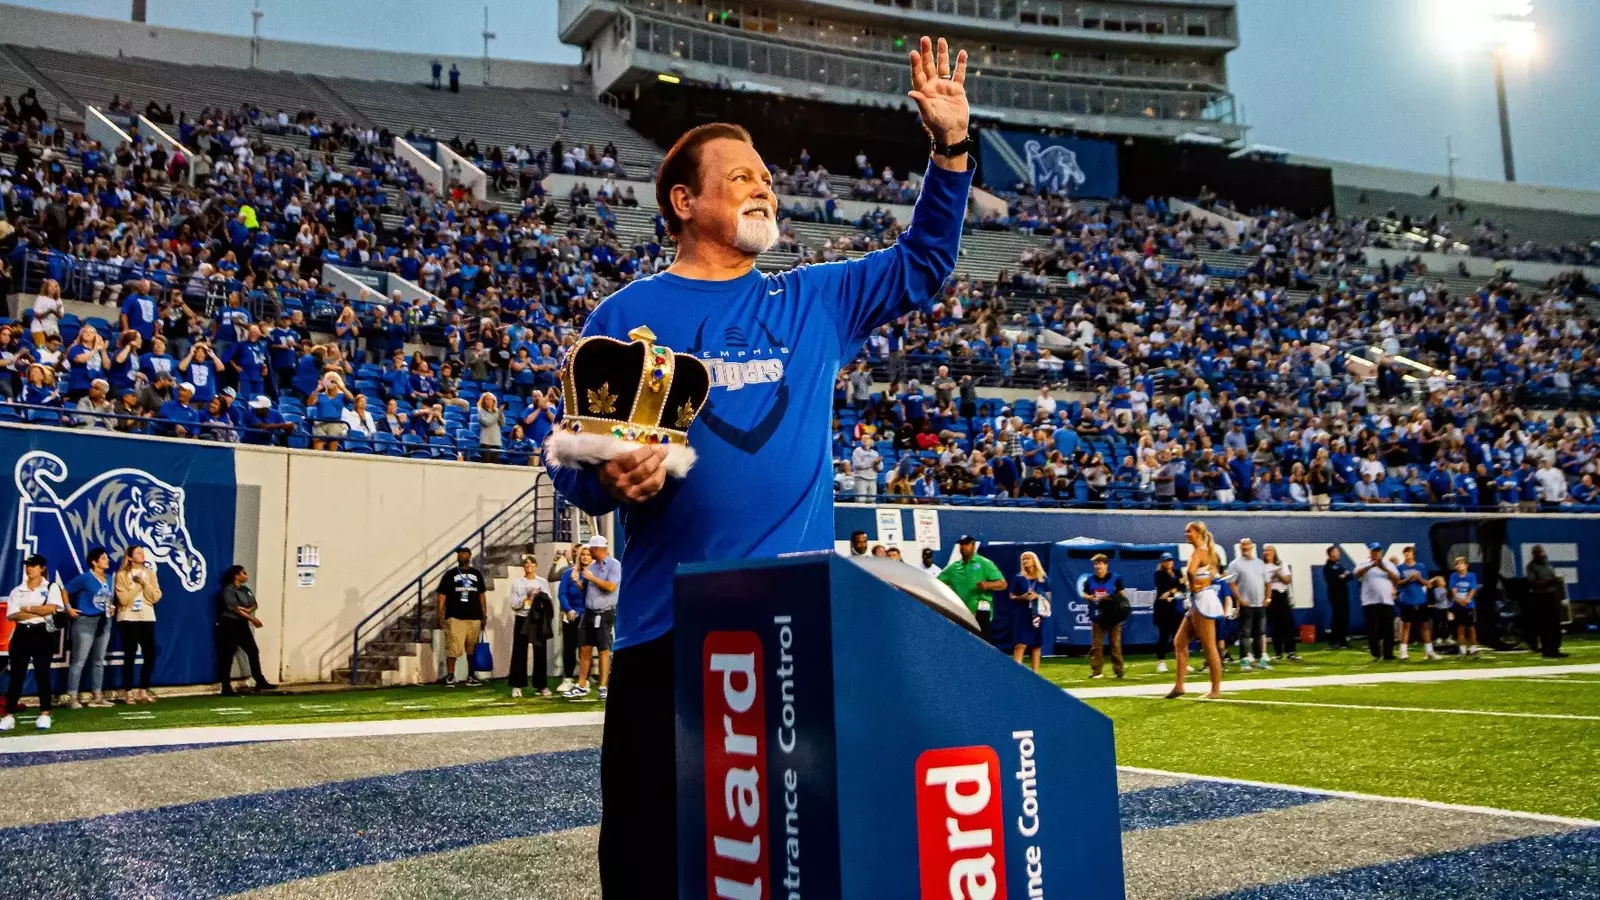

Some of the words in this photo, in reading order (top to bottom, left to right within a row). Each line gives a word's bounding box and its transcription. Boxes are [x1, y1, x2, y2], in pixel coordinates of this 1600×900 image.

[702, 347, 789, 358] EMPHIS
[774, 615, 796, 754] Control
[1012, 729, 1040, 837] Control
[1026, 845, 1044, 900] nce
